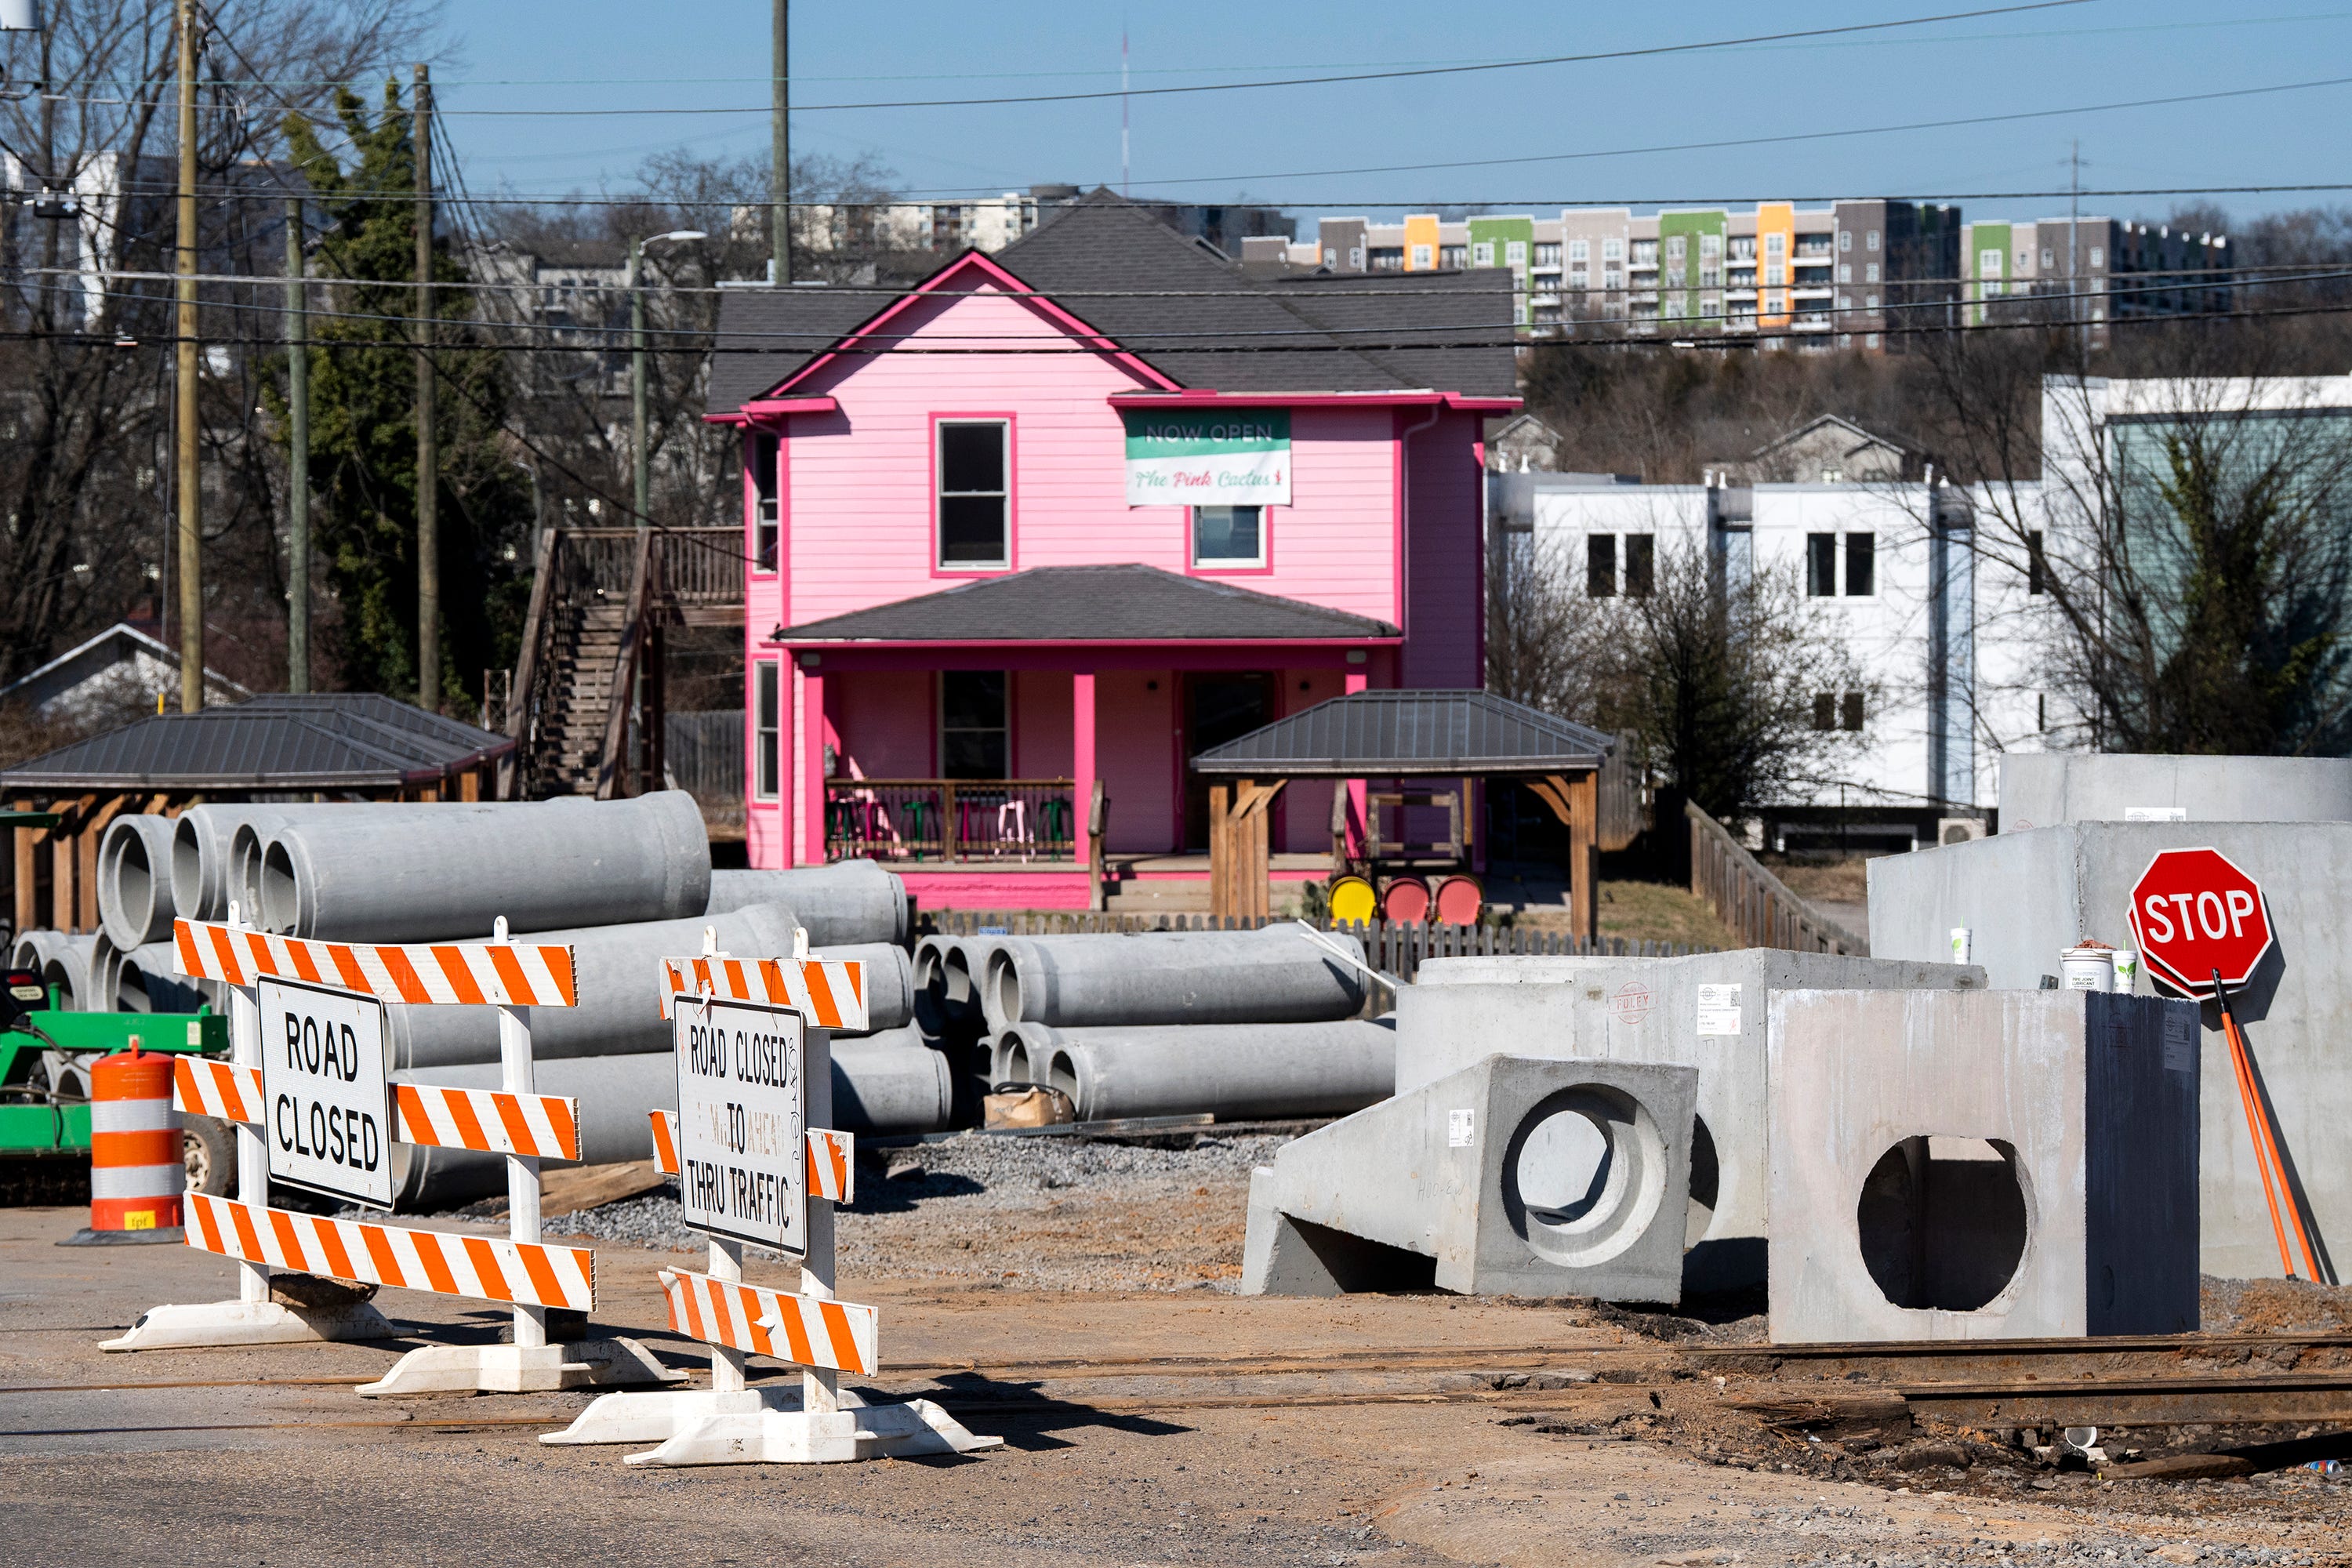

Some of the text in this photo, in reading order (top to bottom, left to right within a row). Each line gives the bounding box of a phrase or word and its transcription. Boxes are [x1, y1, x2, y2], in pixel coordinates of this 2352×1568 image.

[1145, 424, 1272, 443] NOW OPEN
[1135, 469, 1270, 488] The Pink Cactus
[2145, 890, 2255, 943] STOP
[1617, 995, 1649, 1010] FOLEY
[285, 1012, 358, 1082] ROAD
[690, 1025, 727, 1078] ROAD
[735, 1030, 788, 1088] CLOSED
[277, 1094, 379, 1172] CLOSED
[727, 1102, 745, 1155] TO
[688, 1160, 789, 1229] THRU TRAFFIC
